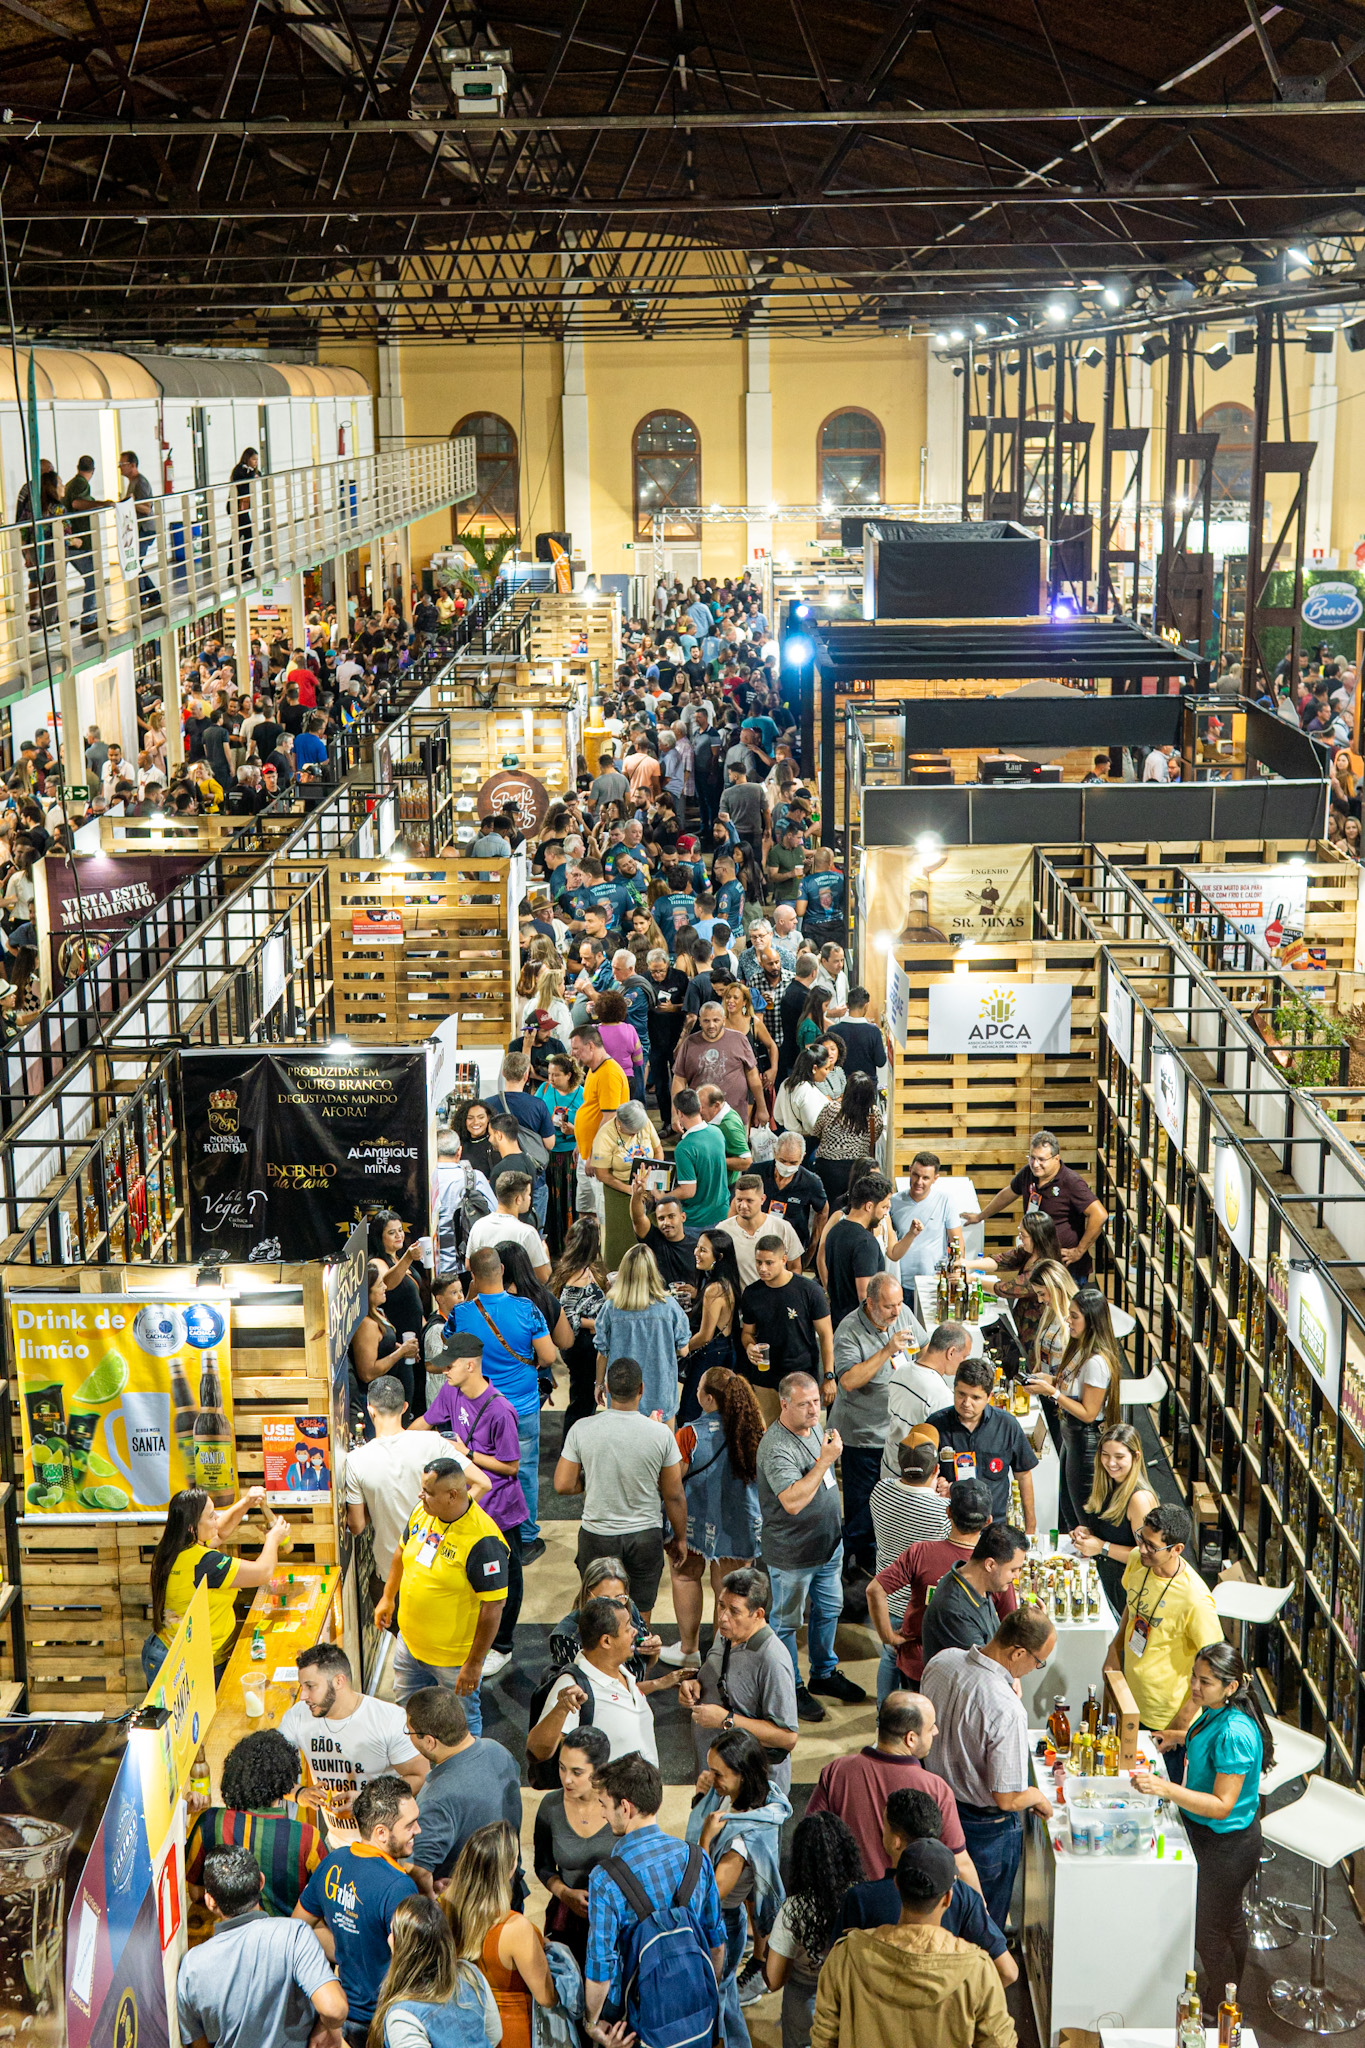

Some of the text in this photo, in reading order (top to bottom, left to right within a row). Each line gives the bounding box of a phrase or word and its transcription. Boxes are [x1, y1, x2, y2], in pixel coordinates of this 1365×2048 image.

[1306, 598, 1357, 620] Brasil
[61, 882, 150, 912] VISTA ESTE
[60, 893, 158, 926] MOVIMENTO!
[952, 917, 1025, 928] SR. MINAS
[968, 1024, 1032, 1040] APCA
[287, 1066, 379, 1077] PRODUZIDAS EM
[296, 1079, 336, 1091] OURO
[278, 1093, 398, 1104] DEGUSTADAS MUNDO
[321, 1106, 367, 1117] AFORA!
[210, 1135, 241, 1144] NOSSA
[203, 1143, 248, 1154] RAINHA
[347, 1147, 418, 1159] ALAMBIQUE
[376, 1157, 388, 1165] DE
[266, 1162, 338, 1177] ENGENHO
[364, 1164, 401, 1174] MINAS
[272, 1174, 330, 1190] da Cana
[201, 1193, 246, 1232] Vega
[17, 1308, 126, 1330] Drink de
[19, 1338, 90, 1359] limão
[263, 1424, 295, 1436] USE
[132, 1436, 166, 1452] SANTA
[199, 1451, 226, 1465] SANTA
[1128, 1588, 1150, 1613] Lee
[311, 1736, 342, 1753] BÃO &
[311, 1758, 364, 1774] BUNITO &
[317, 1777, 357, 1793] OTOSO
